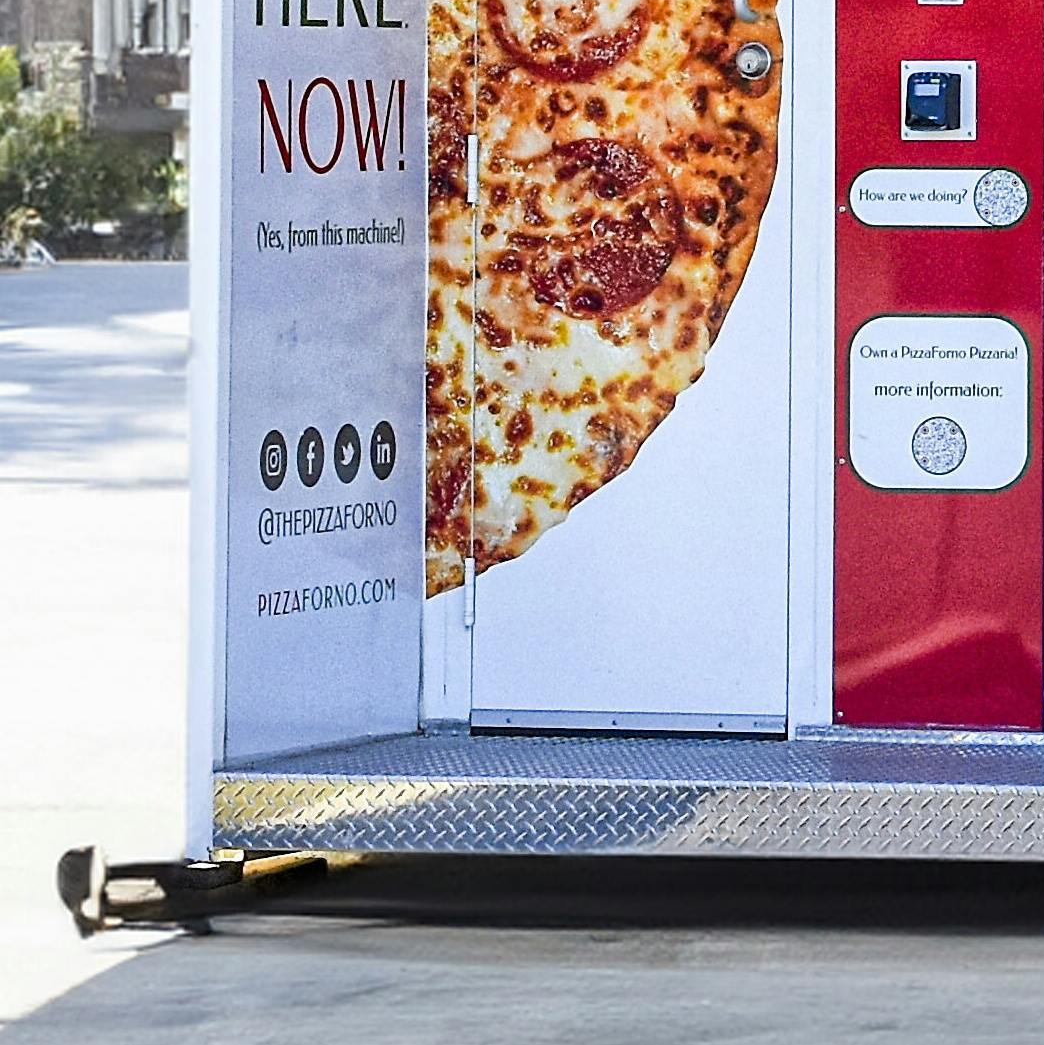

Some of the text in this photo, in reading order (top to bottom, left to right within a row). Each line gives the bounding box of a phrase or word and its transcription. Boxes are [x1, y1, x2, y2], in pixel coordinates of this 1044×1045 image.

[257, 77, 406, 175] NOW!
[860, 189, 968, 204] How are we doing?
[257, 217, 405, 253] (Yes, from this machine!)
[860, 345, 887, 359] Own
[890, 350, 898, 358] a
[901, 345, 967, 359] PizzaForno
[874, 381, 1003, 400] more information:
[258, 500, 397, 545] @THEPIZZAFORNO
[258, 578, 396, 617] PIZZAFORNO.COM
